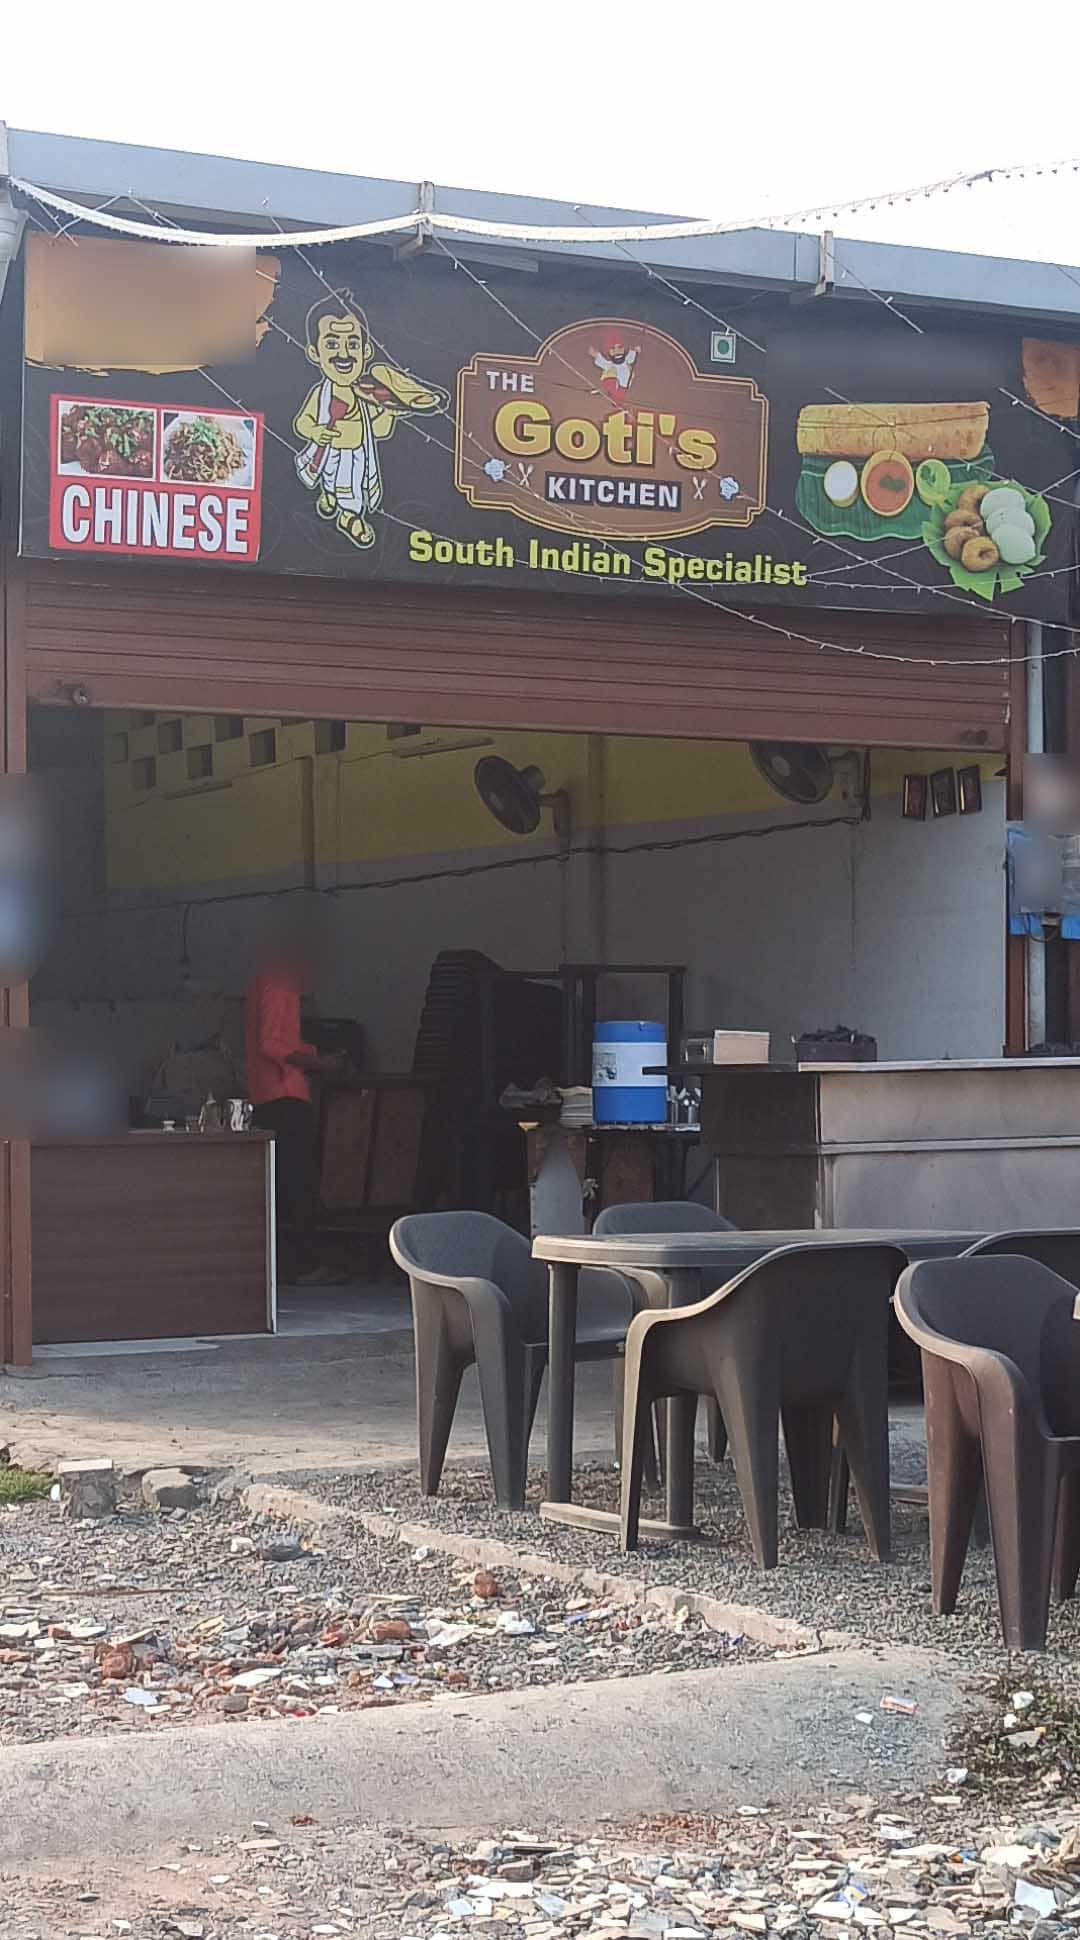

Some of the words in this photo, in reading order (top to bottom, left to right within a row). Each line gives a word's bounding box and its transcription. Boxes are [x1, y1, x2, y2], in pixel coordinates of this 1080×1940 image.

[486, 371, 534, 393] THE
[495, 400, 718, 470] Goti's
[61, 484, 250, 554] CHINESE
[547, 477, 679, 508] KITCHEN
[409, 530, 514, 568] South
[529, 540, 631, 575] Indian
[643, 547, 808, 586] Specialist
